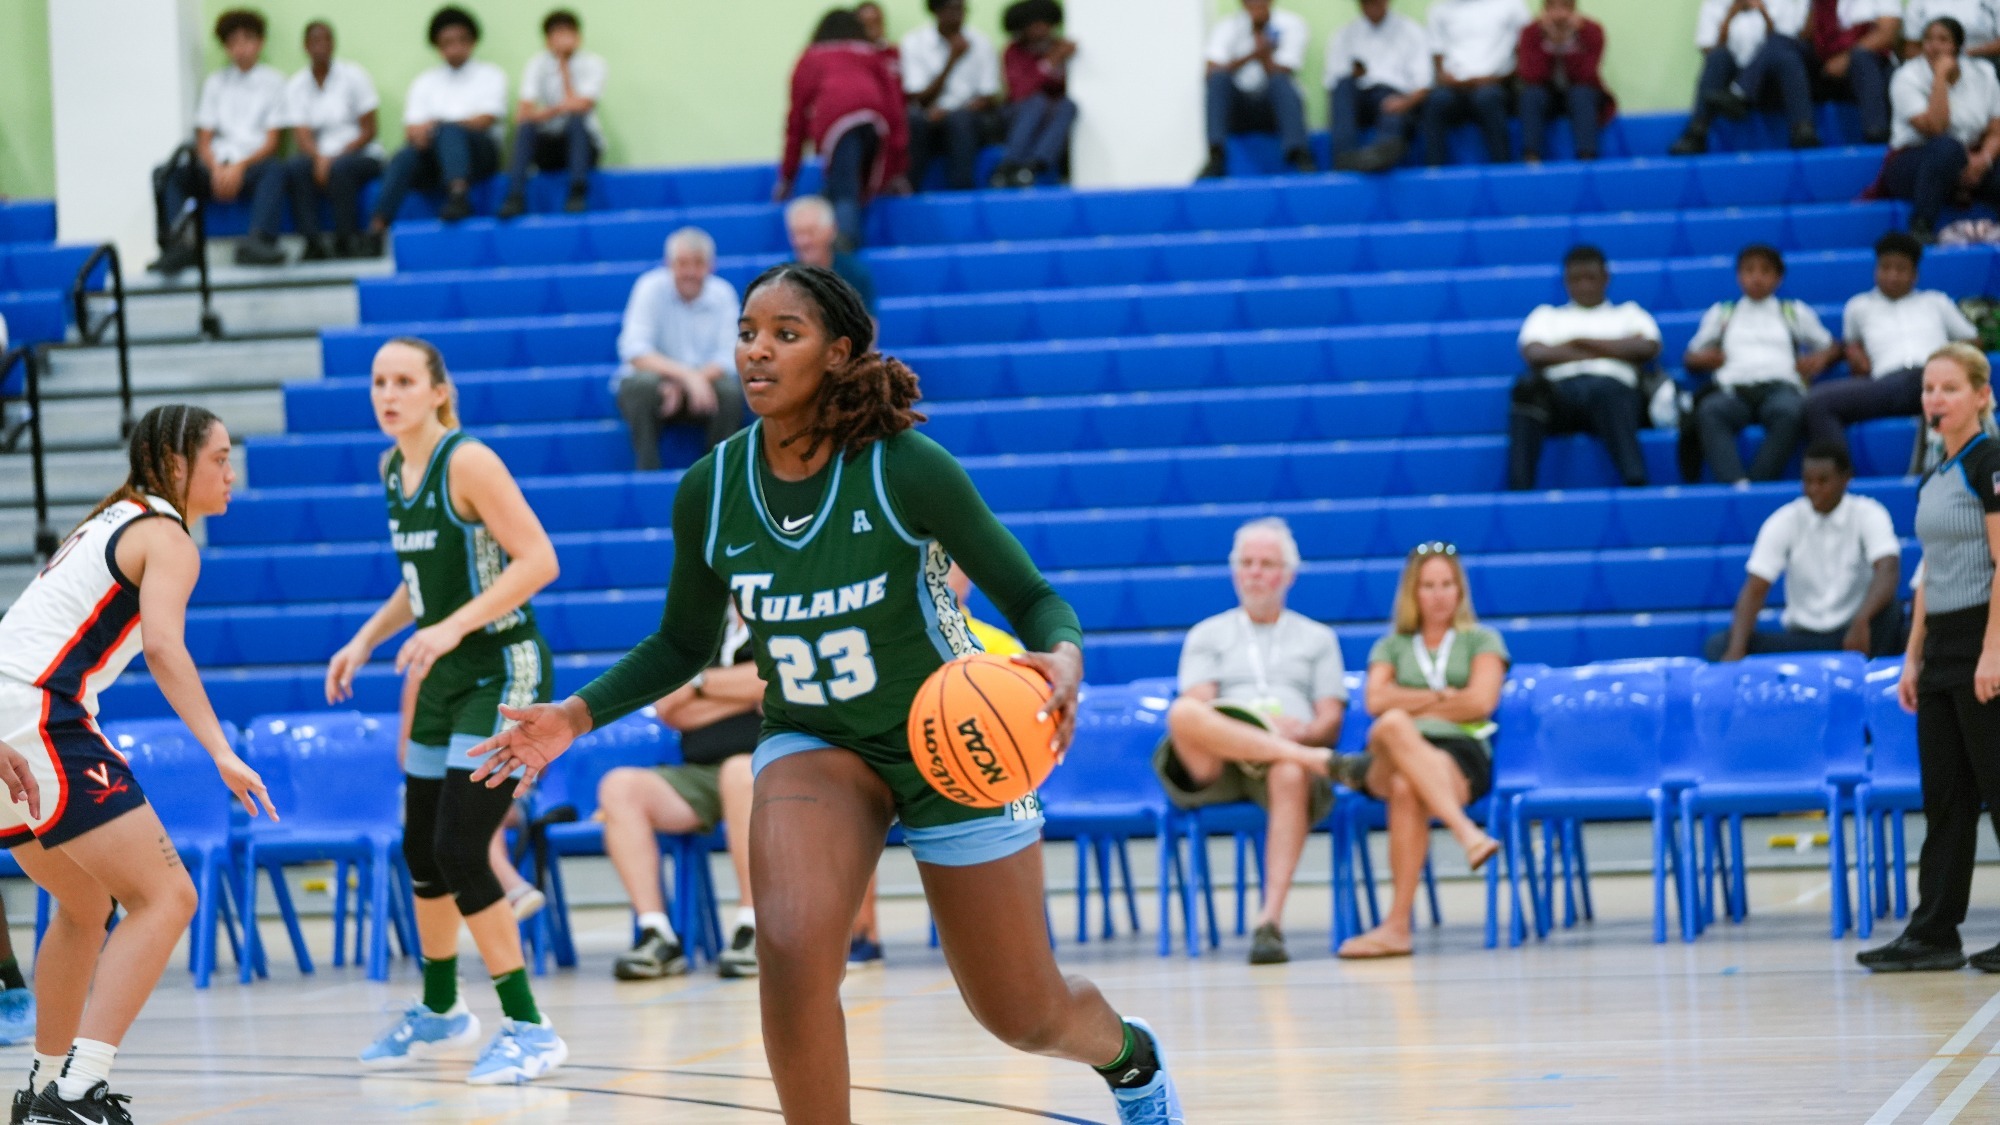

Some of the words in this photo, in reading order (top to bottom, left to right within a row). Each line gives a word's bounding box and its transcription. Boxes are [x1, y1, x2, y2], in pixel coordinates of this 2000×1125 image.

[853, 510, 873, 534] A
[731, 572, 889, 622] TULANE
[767, 626, 878, 706] 23
[923, 717, 977, 803] Wilson
[957, 717, 1008, 785] NCAA
